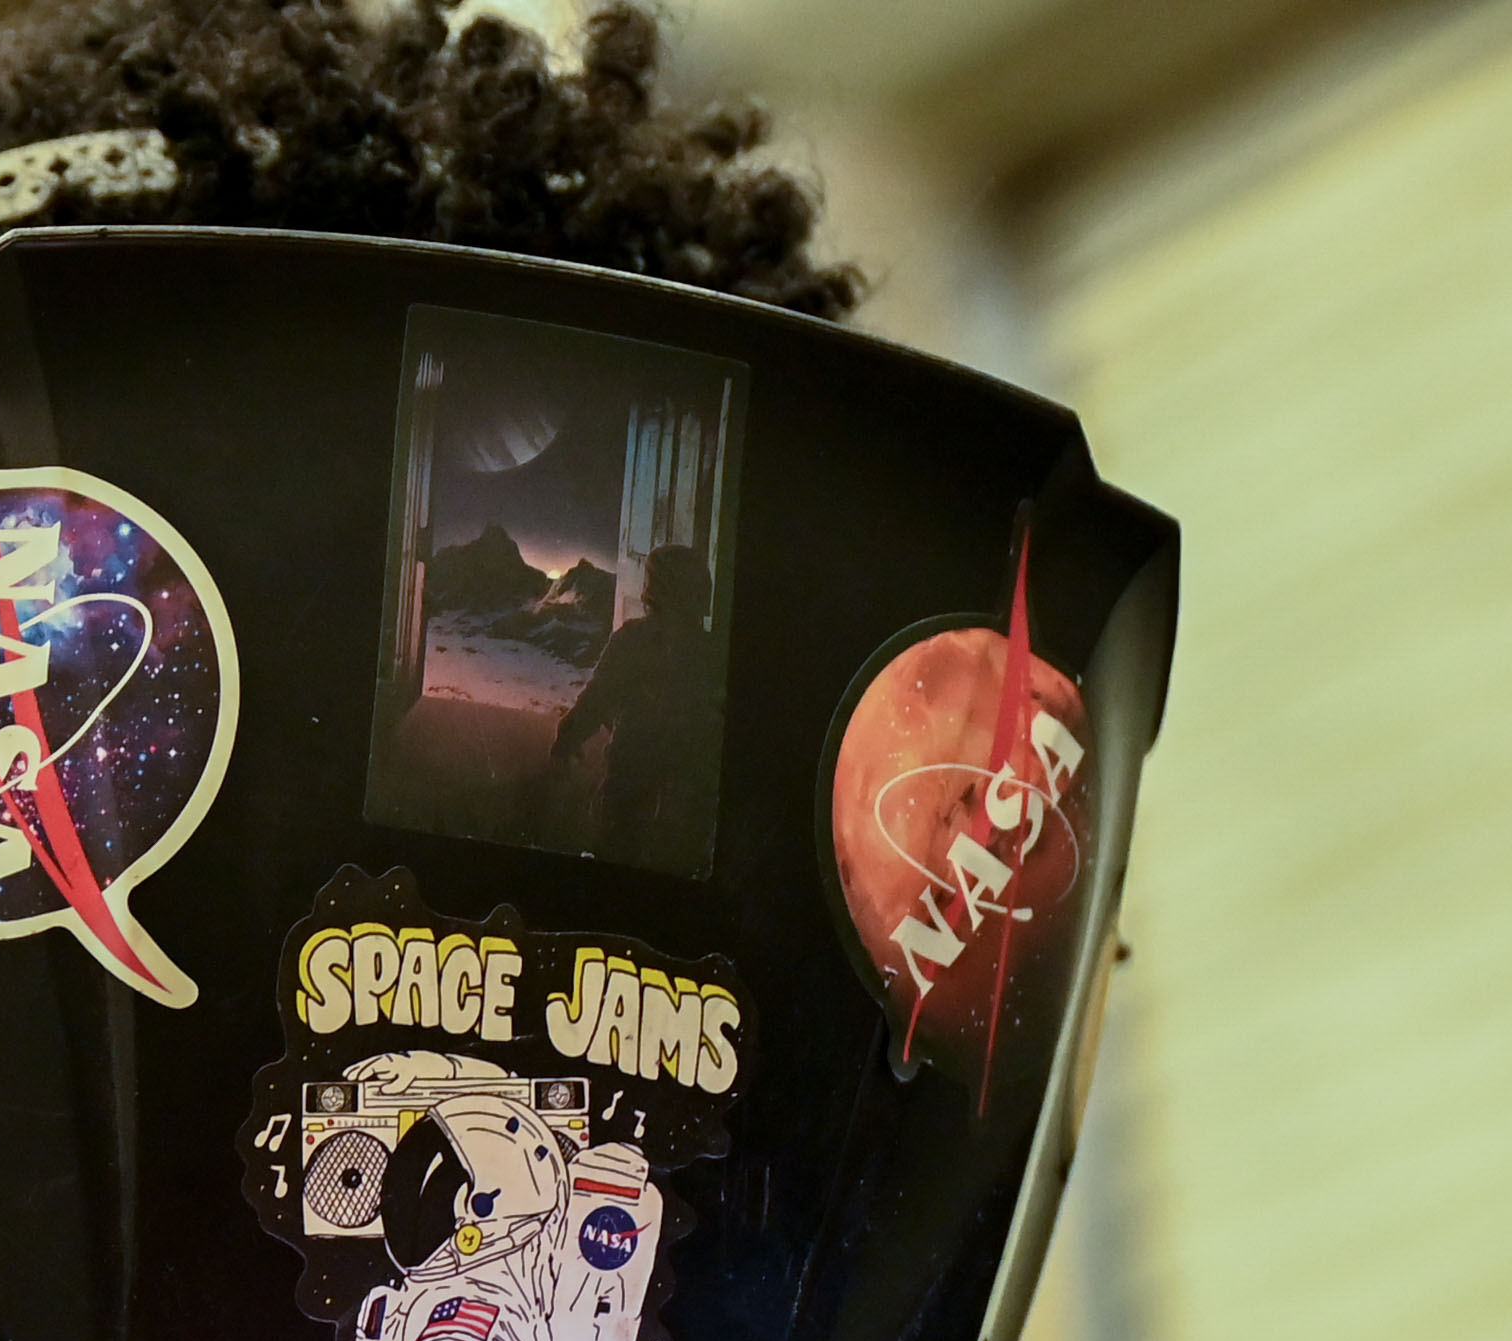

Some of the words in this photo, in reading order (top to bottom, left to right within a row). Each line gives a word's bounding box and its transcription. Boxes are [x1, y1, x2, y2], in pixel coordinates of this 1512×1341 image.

[888, 709, 1085, 999] NASA
[295, 922, 522, 1042] SPACE
[544, 947, 741, 1094] JAMS
[582, 1223, 632, 1254] NASA
